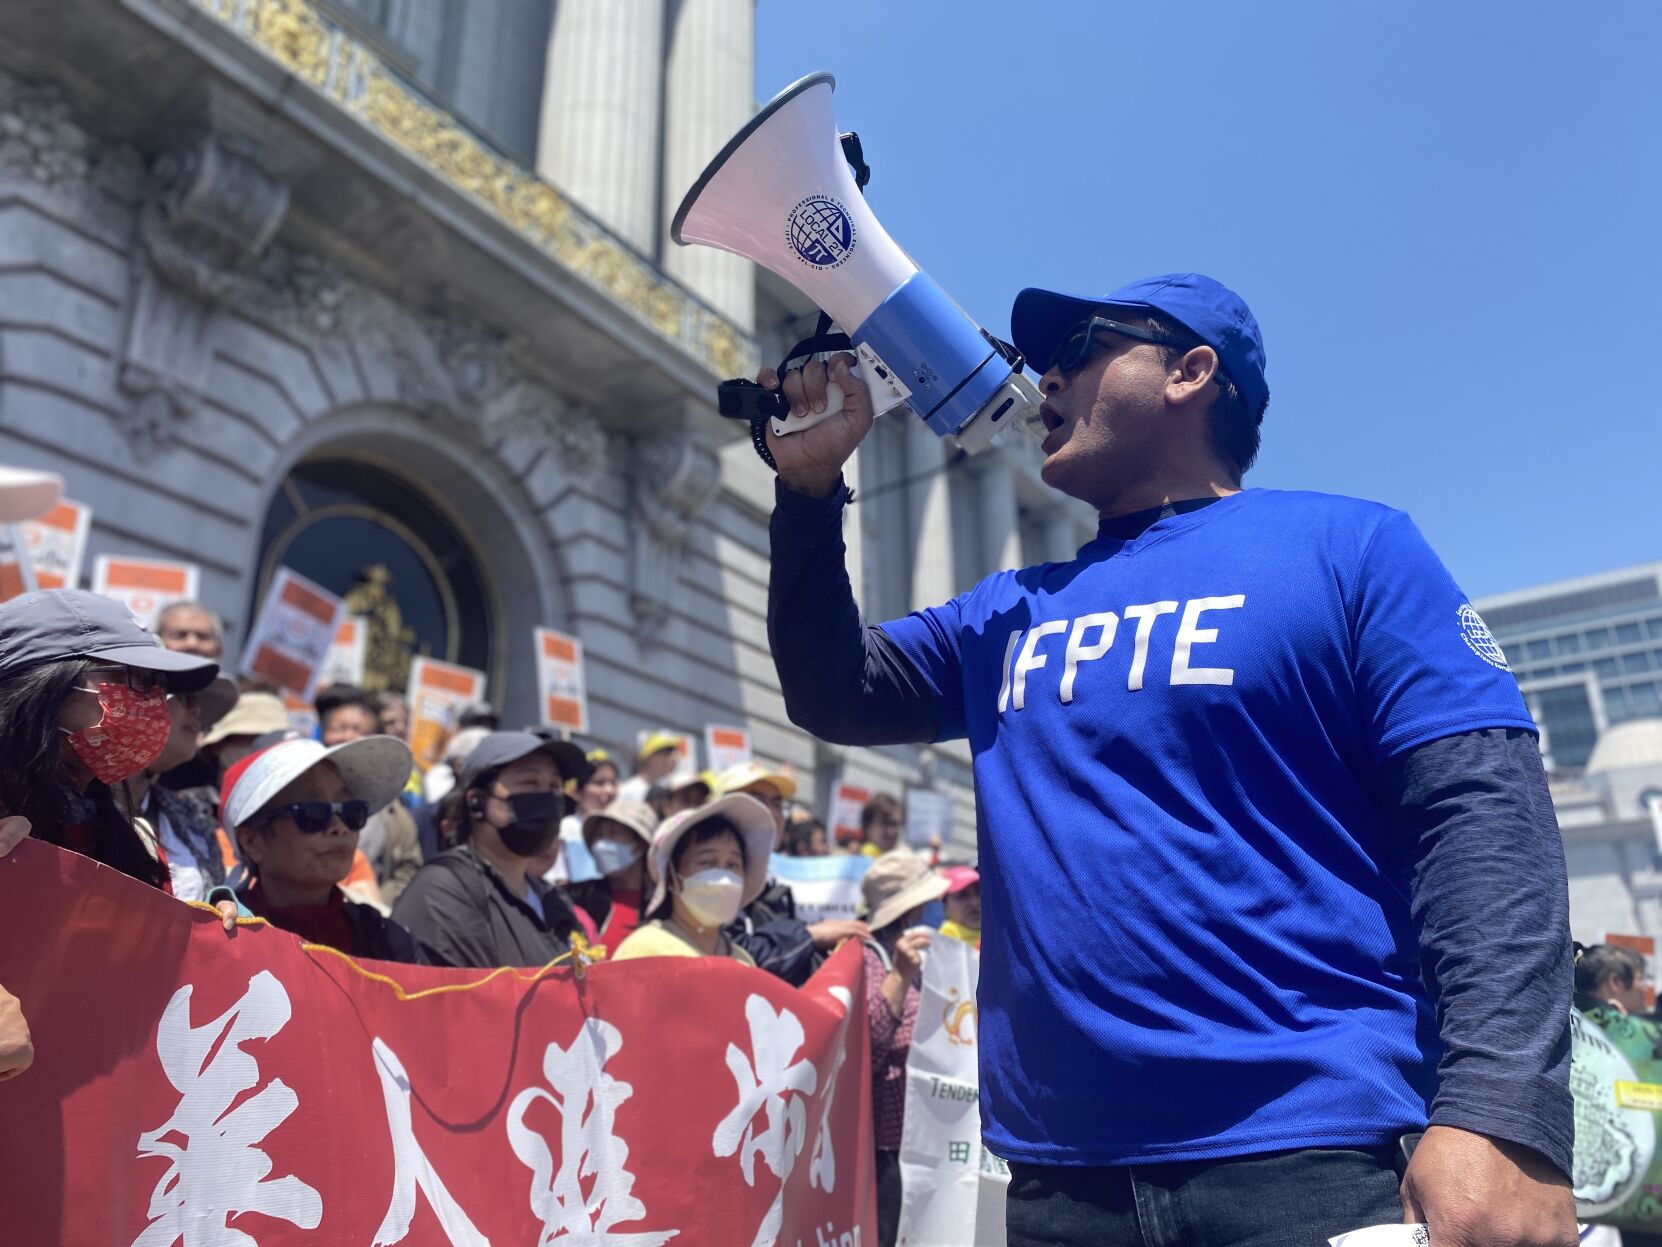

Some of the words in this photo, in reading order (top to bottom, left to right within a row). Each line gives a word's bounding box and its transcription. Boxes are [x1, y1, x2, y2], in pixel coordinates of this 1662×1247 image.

[788, 195, 828, 222] PROFESSIONAL
[837, 202, 856, 236] TECHNICAL
[785, 231, 793, 249] IFPTE
[800, 210, 829, 244] LOCAL
[829, 242, 844, 257] 21
[797, 256, 822, 270] AFL-CIO
[832, 240, 856, 269] ENGINEERS
[998, 595, 1245, 713] IFPTE
[1460, 632, 1494, 666] Champions
